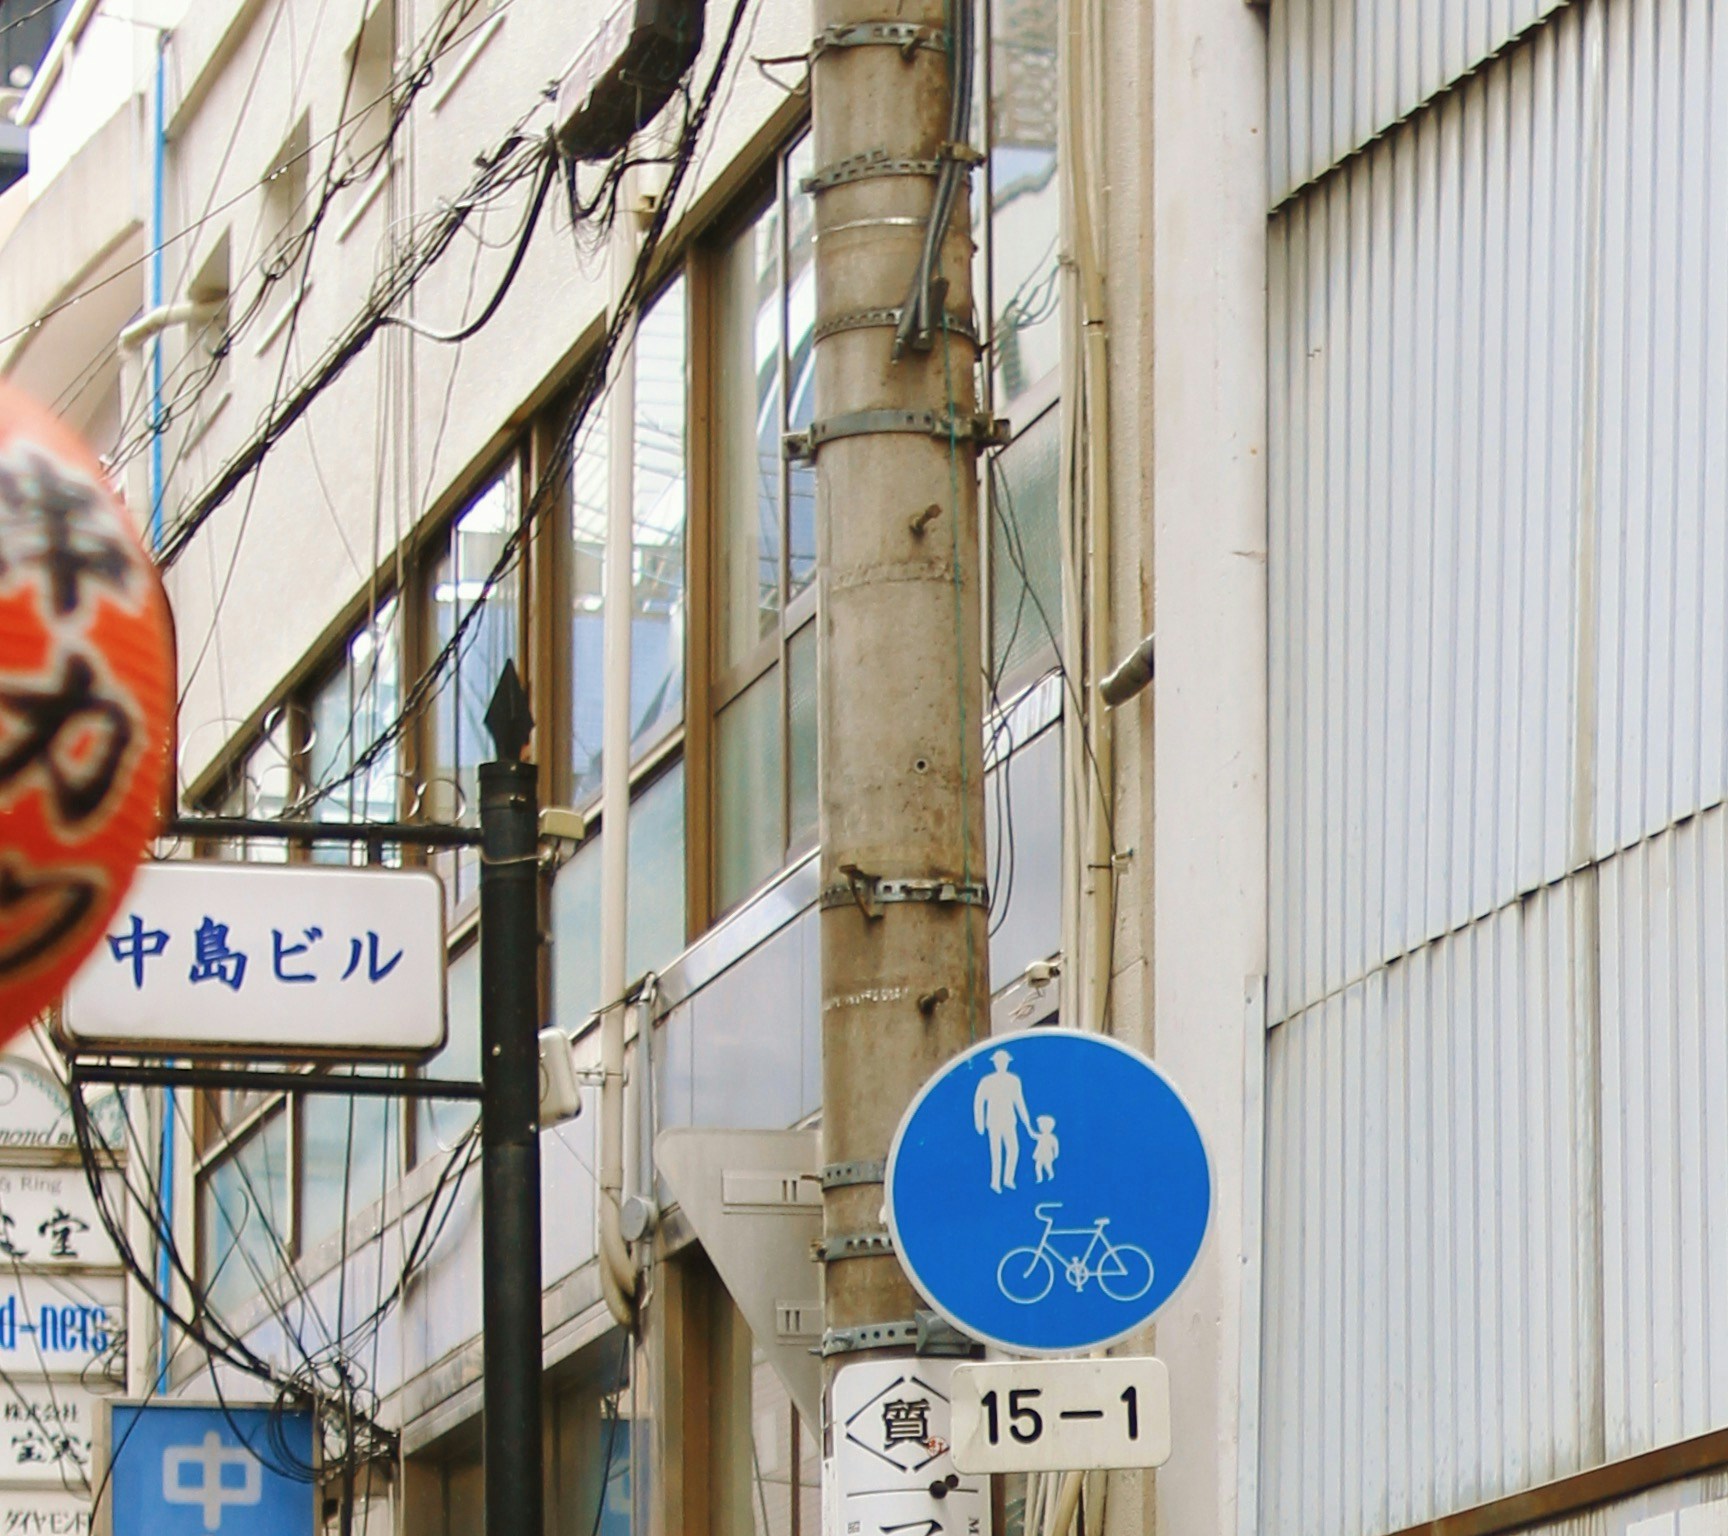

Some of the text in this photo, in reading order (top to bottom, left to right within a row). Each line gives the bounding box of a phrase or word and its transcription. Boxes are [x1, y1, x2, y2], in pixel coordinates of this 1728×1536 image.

[107, 914, 403, 991] 中島ビル
[882, 1398, 931, 1451] 質
[981, 1386, 1140, 1446] 15-1
